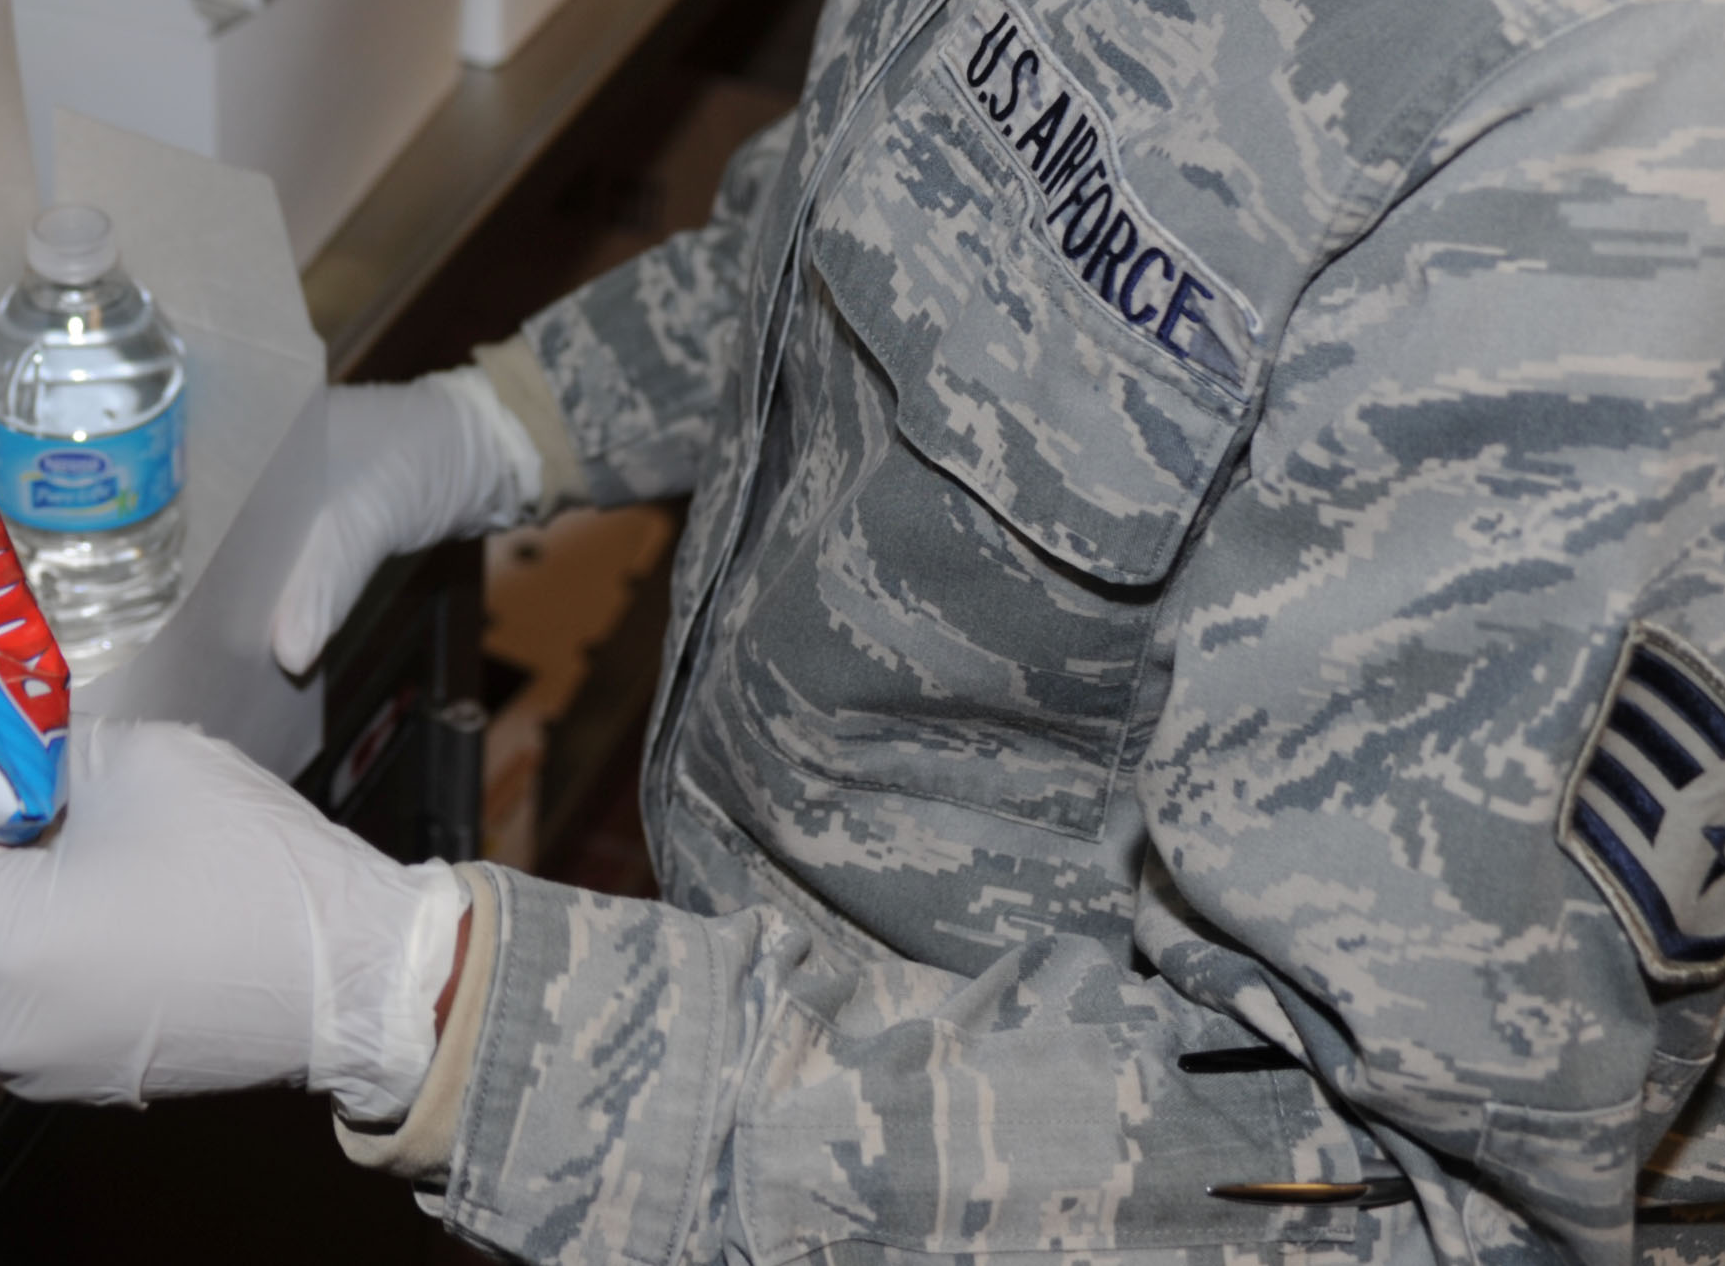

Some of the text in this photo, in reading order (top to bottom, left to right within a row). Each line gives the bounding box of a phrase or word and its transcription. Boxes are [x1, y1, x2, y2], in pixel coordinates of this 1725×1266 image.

[966, 11, 1215, 360] U.S. AIR FORCE
